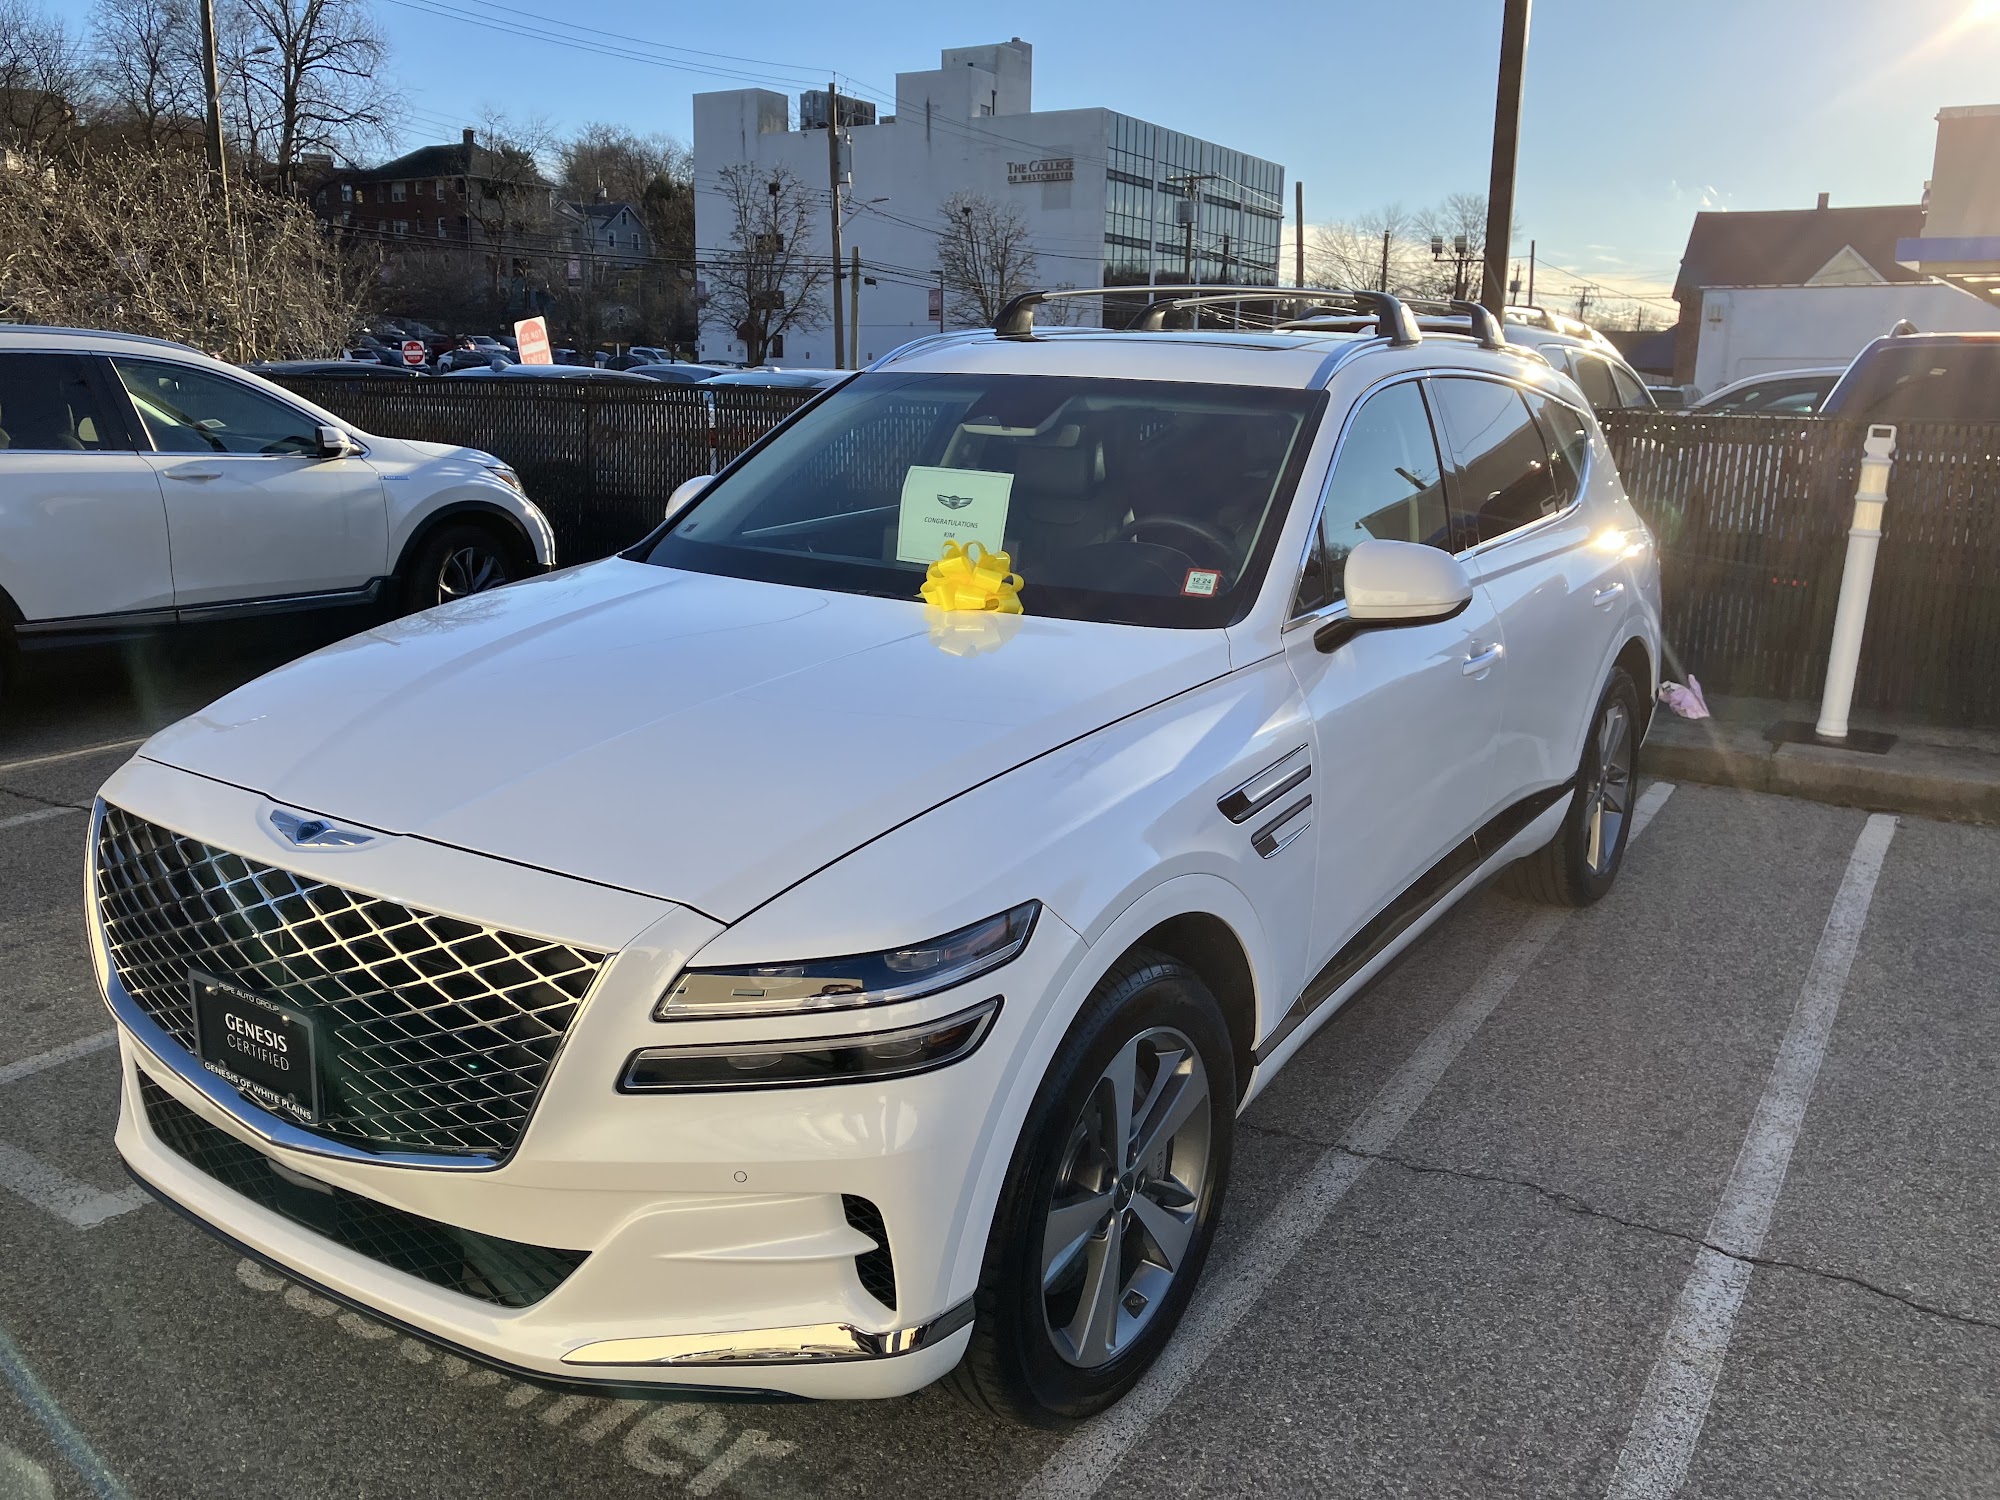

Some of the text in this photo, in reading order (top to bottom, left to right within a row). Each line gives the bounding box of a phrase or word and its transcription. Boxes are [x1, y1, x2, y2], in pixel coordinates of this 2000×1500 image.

[1029, 160, 1074, 172] COLLEGE
[1021, 172, 1073, 181] WESTCHESTER
[521, 329, 542, 342] DO NOT
[924, 516, 979, 528] CONGRATULATIONS
[943, 531, 956, 539] KIM
[218, 982, 280, 1012] PEPE AUTO GROUP
[224, 1012, 288, 1053] GENESIS
[226, 1033, 290, 1071] CERTIFIED
[204, 1062, 312, 1120] GENESIS OF WHITE PLAINS
